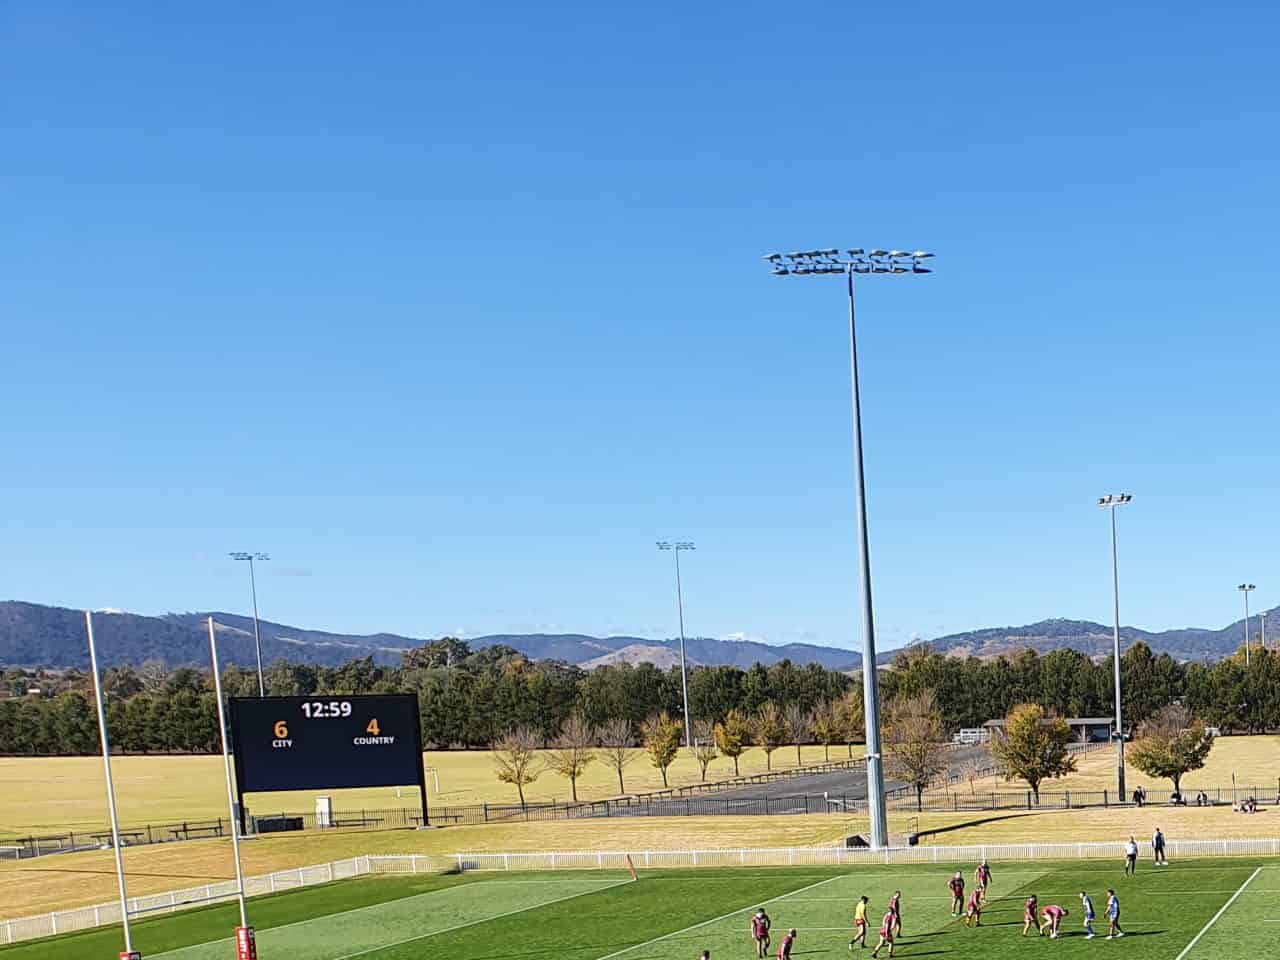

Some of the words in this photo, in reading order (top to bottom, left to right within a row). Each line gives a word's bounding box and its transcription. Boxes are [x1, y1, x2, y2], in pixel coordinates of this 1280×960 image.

[301, 701, 352, 718] 12:59
[273, 720, 288, 738] 6
[365, 718, 380, 735] 4
[272, 739, 292, 748] CITY
[353, 735, 395, 745] COUNTRY
